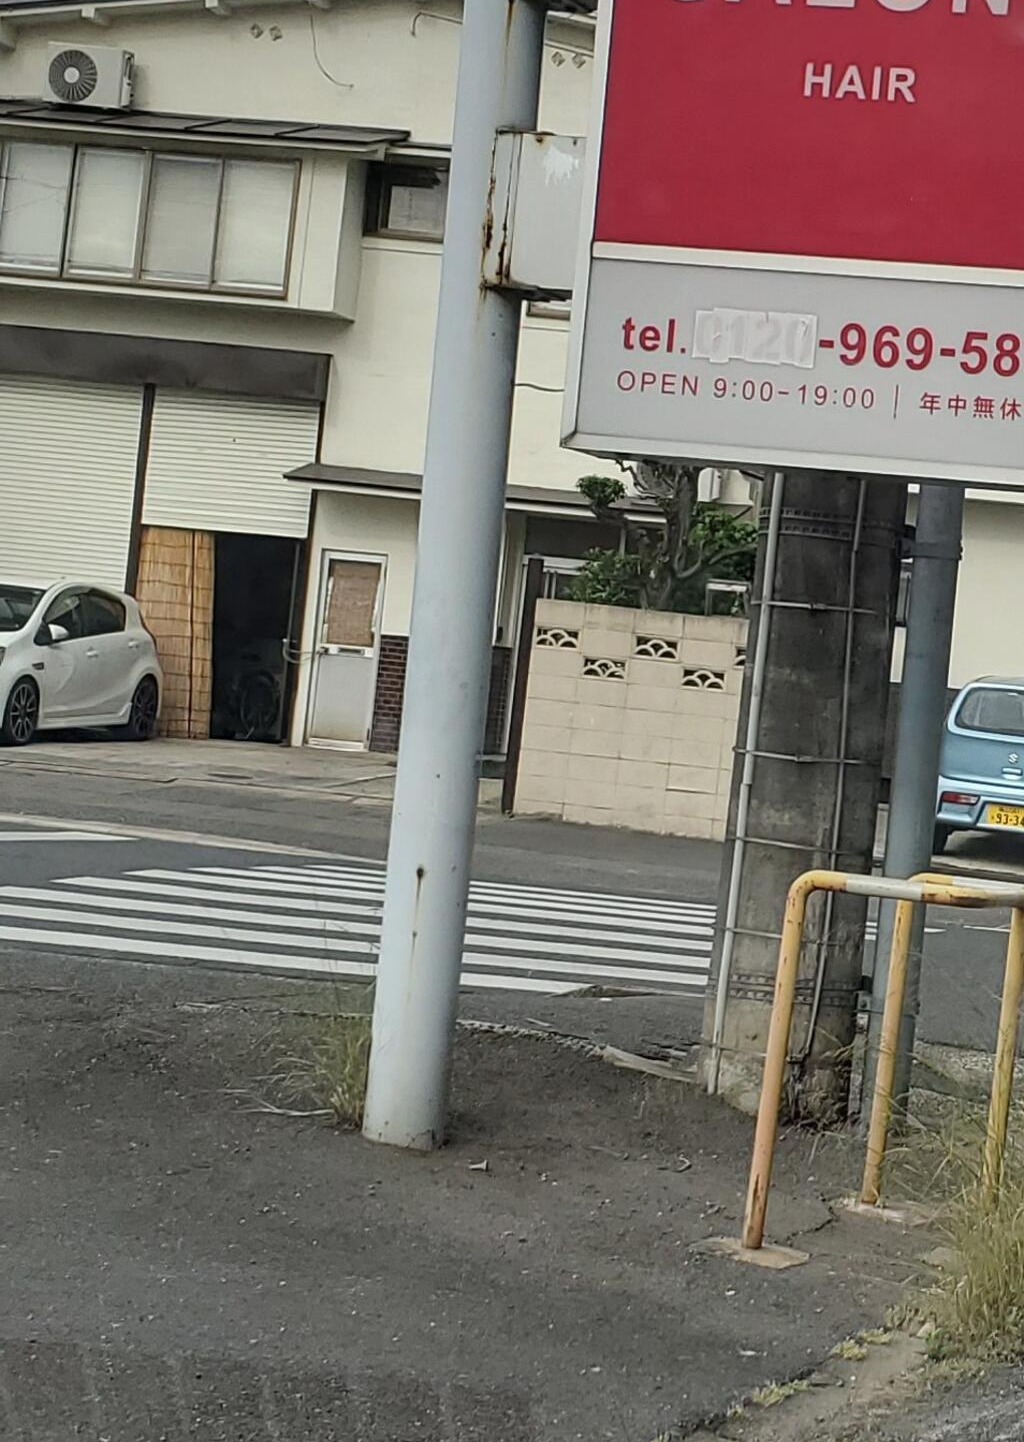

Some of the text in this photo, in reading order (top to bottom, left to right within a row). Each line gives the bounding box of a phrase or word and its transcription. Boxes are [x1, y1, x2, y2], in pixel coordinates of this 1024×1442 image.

[803, 62, 916, 103] HAIR
[617, 370, 1022, 421] OPEN 9:00-19:00 年中無休
